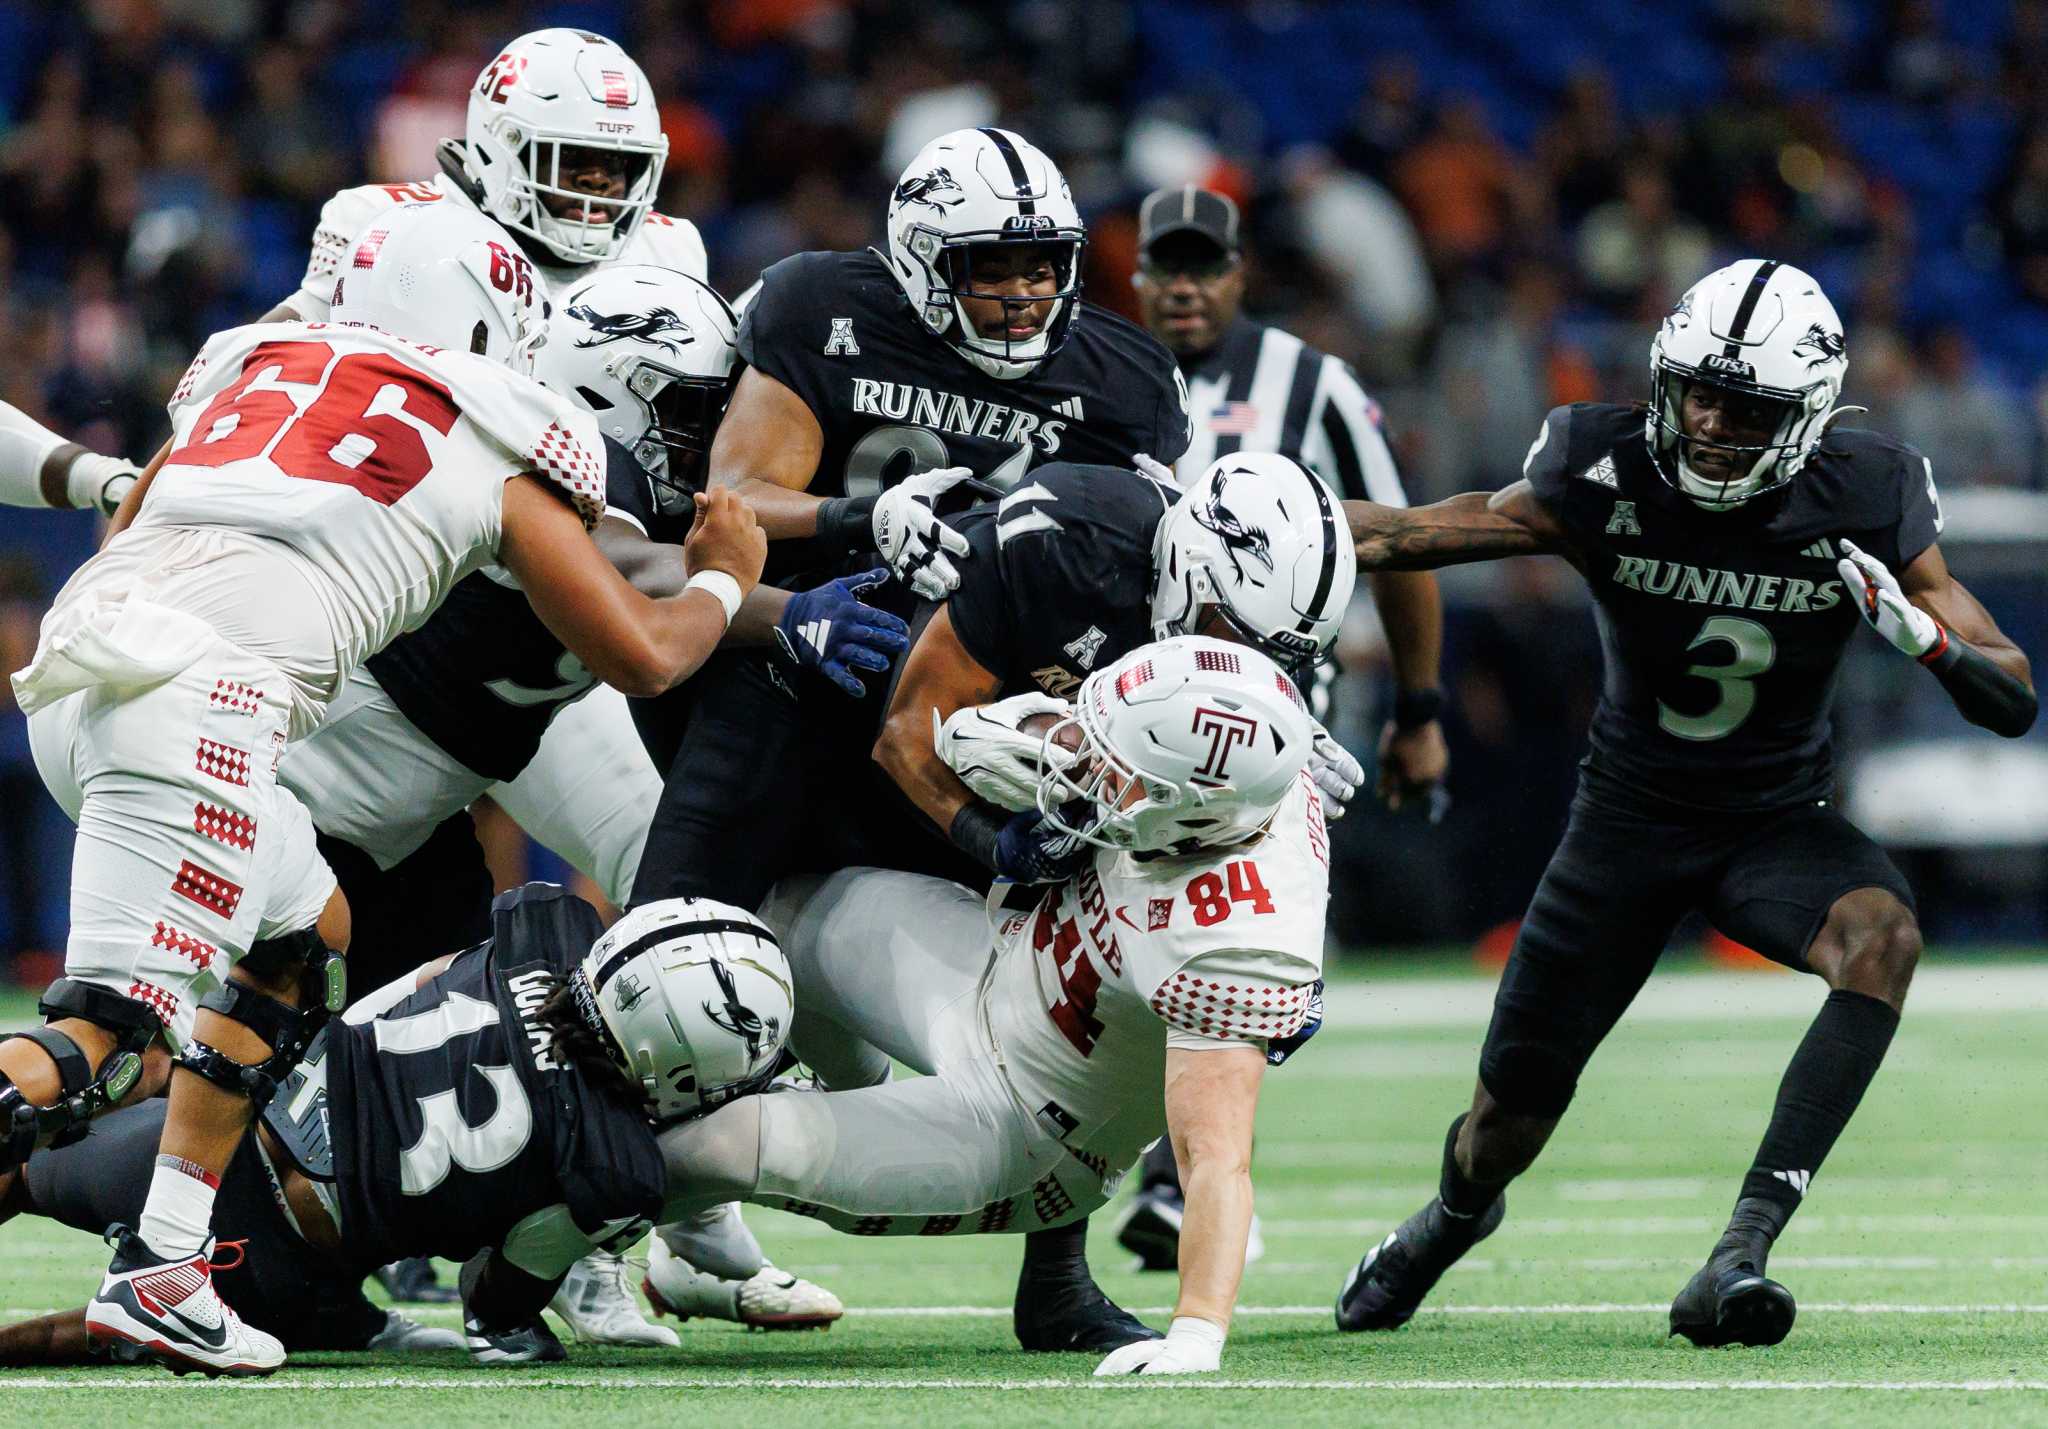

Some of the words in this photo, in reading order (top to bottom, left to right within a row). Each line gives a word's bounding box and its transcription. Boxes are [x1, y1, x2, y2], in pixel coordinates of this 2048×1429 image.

[596, 121, 635, 135] TUFF
[1011, 215, 1051, 230] UTSA
[486, 240, 534, 308] 66
[824, 317, 860, 356] A
[1708, 355, 1750, 376] UTSA
[166, 340, 462, 508] 66
[851, 377, 1067, 455] RUNNERS
[1606, 500, 1642, 536] A
[1613, 553, 1845, 613] RUNNERS
[1063, 625, 1107, 670] A
[1656, 615, 1777, 742] 3
[1191, 707, 1258, 788] T
[1185, 860, 1277, 927] 84
[374, 990, 533, 1197] 13
